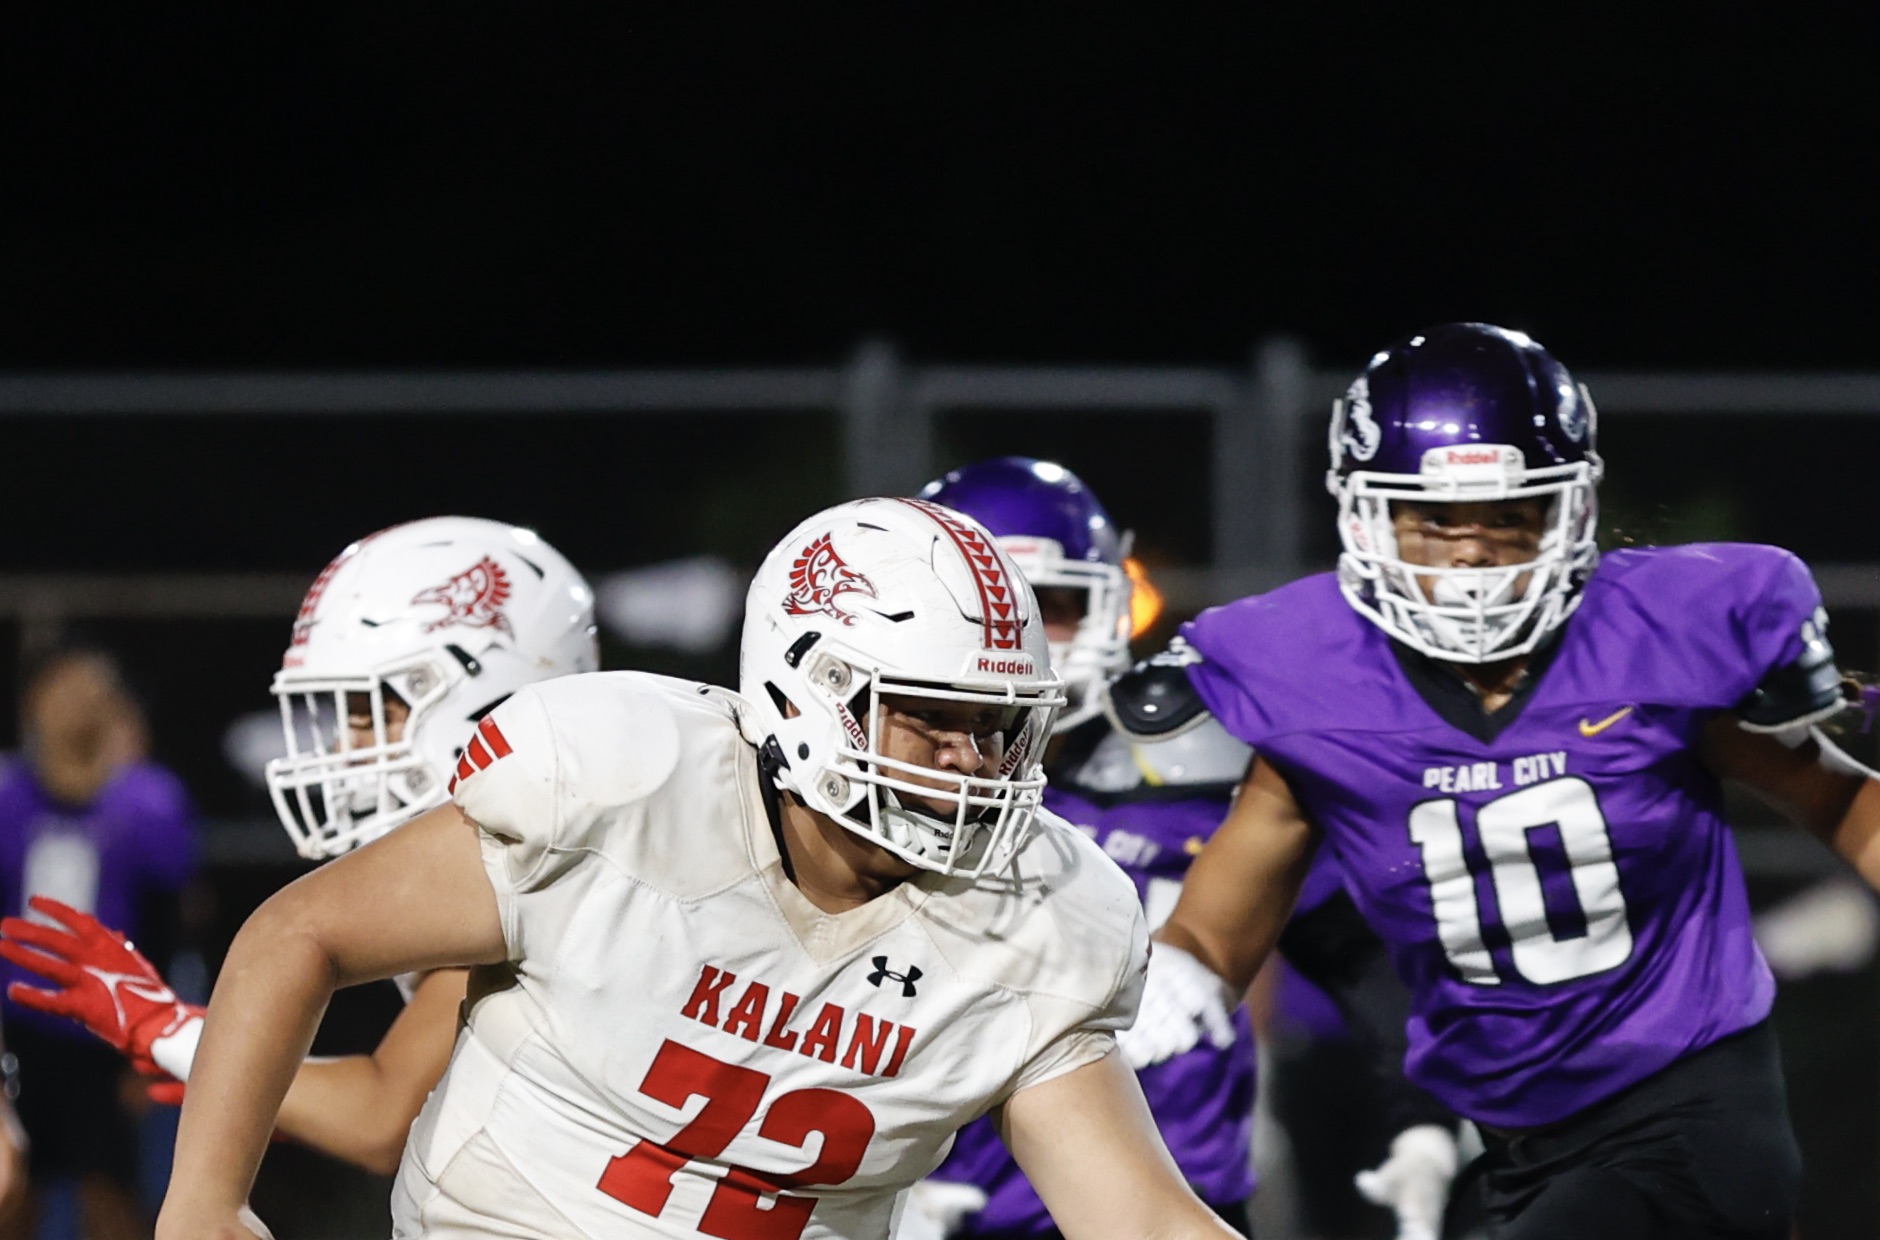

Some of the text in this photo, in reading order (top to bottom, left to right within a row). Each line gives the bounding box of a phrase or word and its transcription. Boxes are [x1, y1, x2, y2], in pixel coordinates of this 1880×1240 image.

[1423, 751, 1567, 793] PEARL CITY
[1408, 776, 1634, 985] 10
[680, 964, 917, 1078] KALANI
